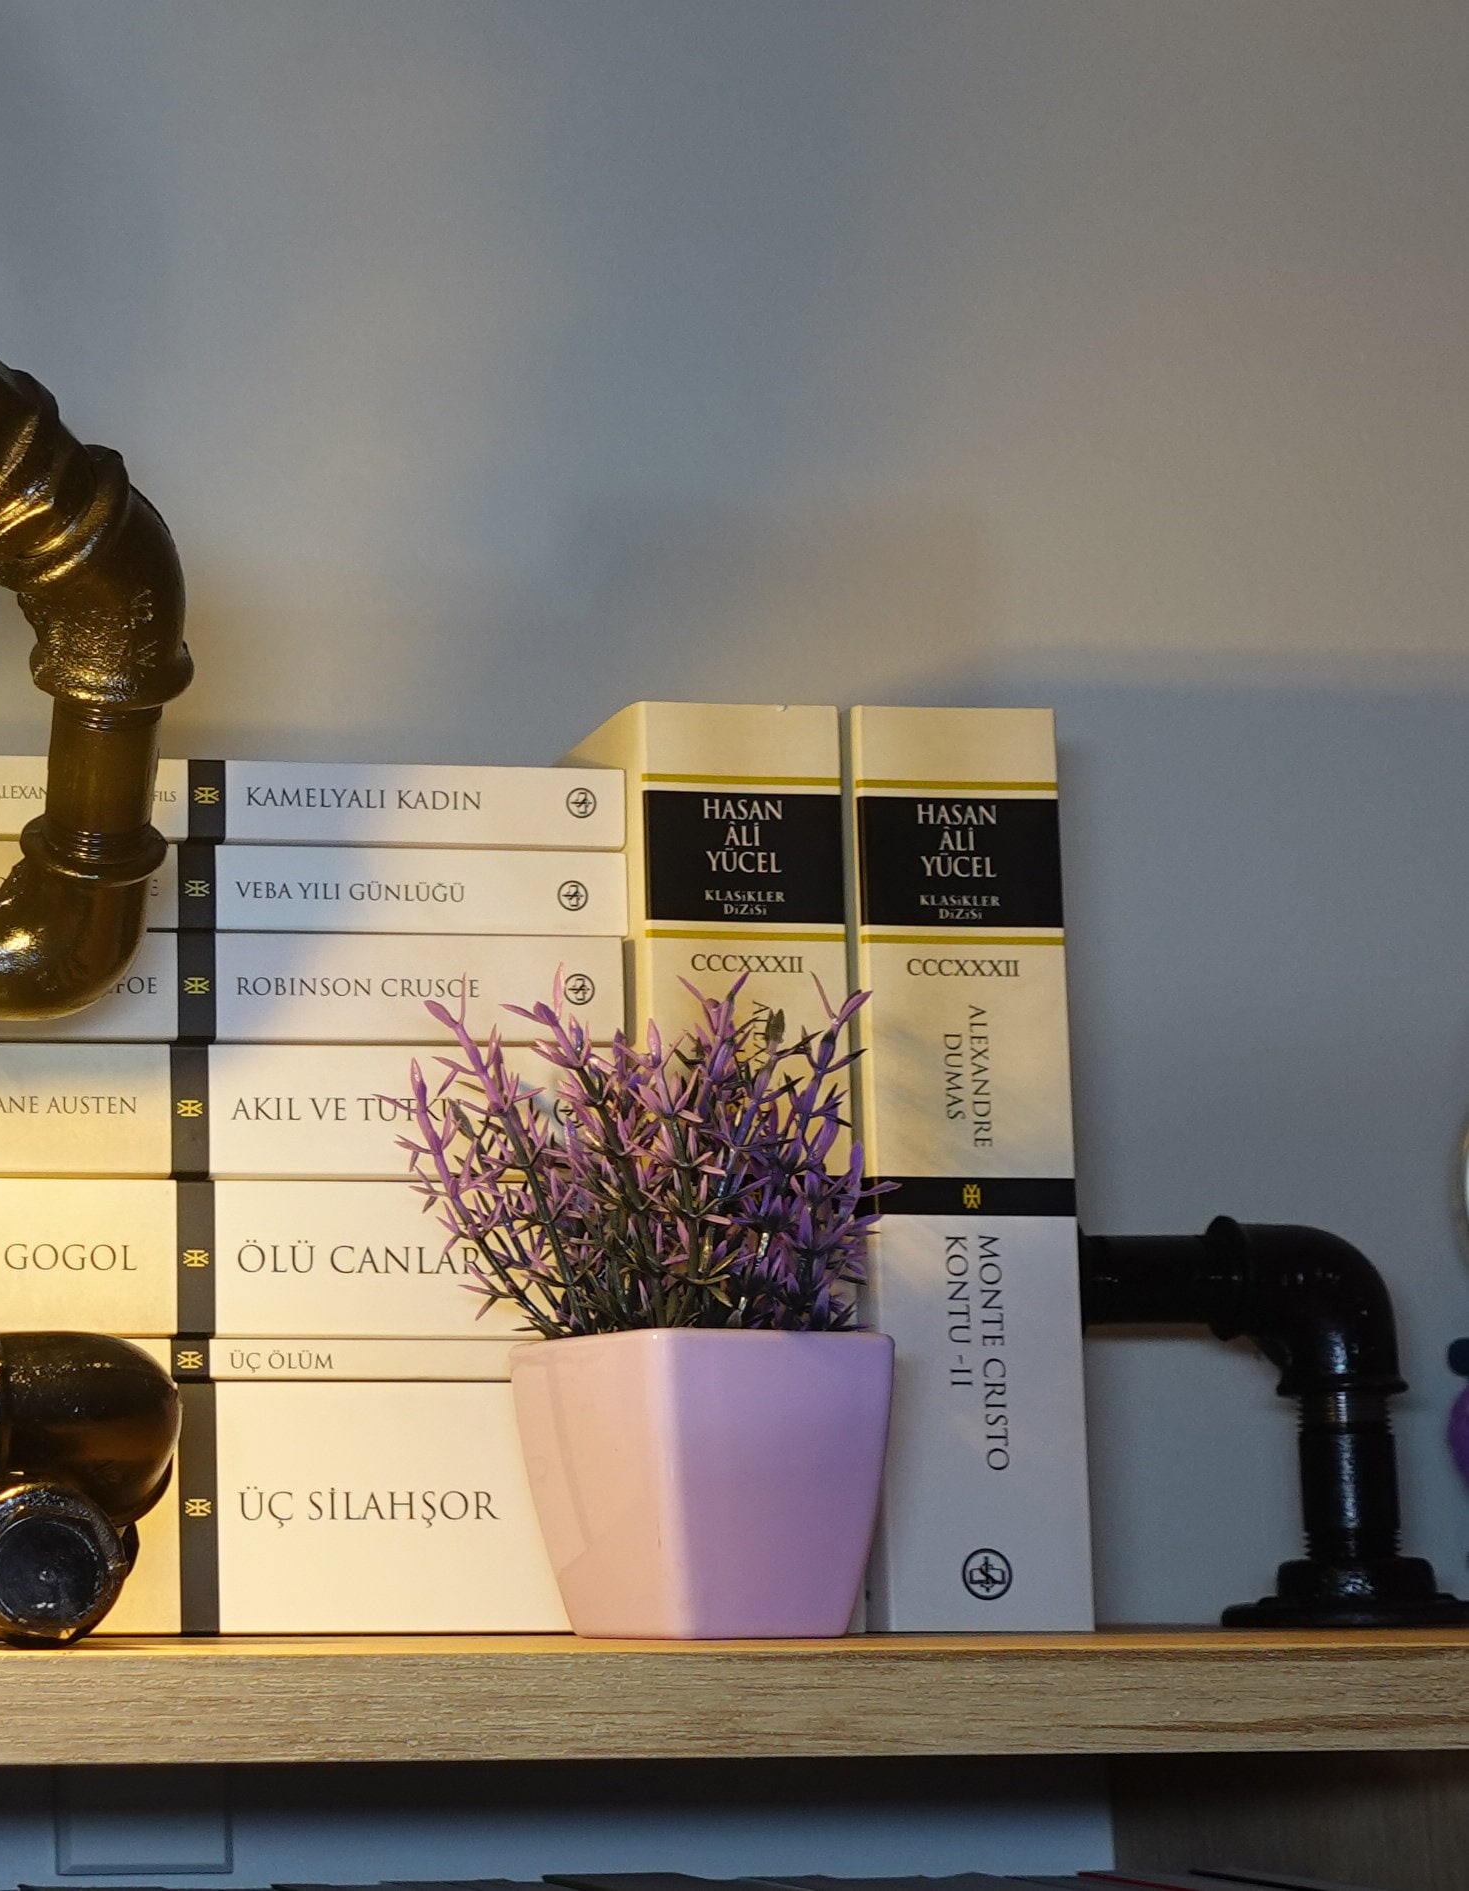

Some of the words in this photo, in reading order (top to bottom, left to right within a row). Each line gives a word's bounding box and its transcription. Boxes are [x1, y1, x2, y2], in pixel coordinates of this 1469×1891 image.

[245, 785, 386, 810] KAMELYALI
[396, 788, 482, 812] KADIN
[702, 798, 783, 821] HASAN
[916, 803, 997, 826] HASAN
[723, 820, 761, 847] ÂLİ
[938, 825, 976, 852] ÂLİ
[705, 847, 783, 874] YÜCEL
[919, 852, 998, 878] YÜCEL
[235, 881, 293, 900] VEBA
[297, 882, 341, 901] YILI
[348, 880, 466, 904] GÜNLÜĞÜ
[690, 953, 804, 974] CCCXXXII
[906, 958, 1020, 978] CCCXXXII
[108, 975, 158, 995] FOE
[235, 976, 372, 998] ROBINSON
[380, 977, 481, 999] CRUSOE
[943, 1032, 966, 1121] DUMAS
[968, 1003, 993, 1148] ALEXANDRE
[46, 1096, 137, 1115] AUSTEN
[230, 1097, 301, 1121] AKIL
[310, 1097, 347, 1121] VE
[4, 1243, 138, 1271] GOGOL
[236, 1239, 315, 1275] ÖLÜ
[330, 1245, 487, 1275] CANLAR
[945, 1236, 972, 1344] KONTU
[977, 1235, 1007, 1347] MONTE
[230, 1350, 261, 1373] ÜÇ
[268, 1350, 334, 1370] ÖLÜM
[982, 1358, 1011, 1471] CRISTO
[237, 1486, 294, 1528] ÜÇ
[307, 1487, 501, 1528] SİLAHŞOR
